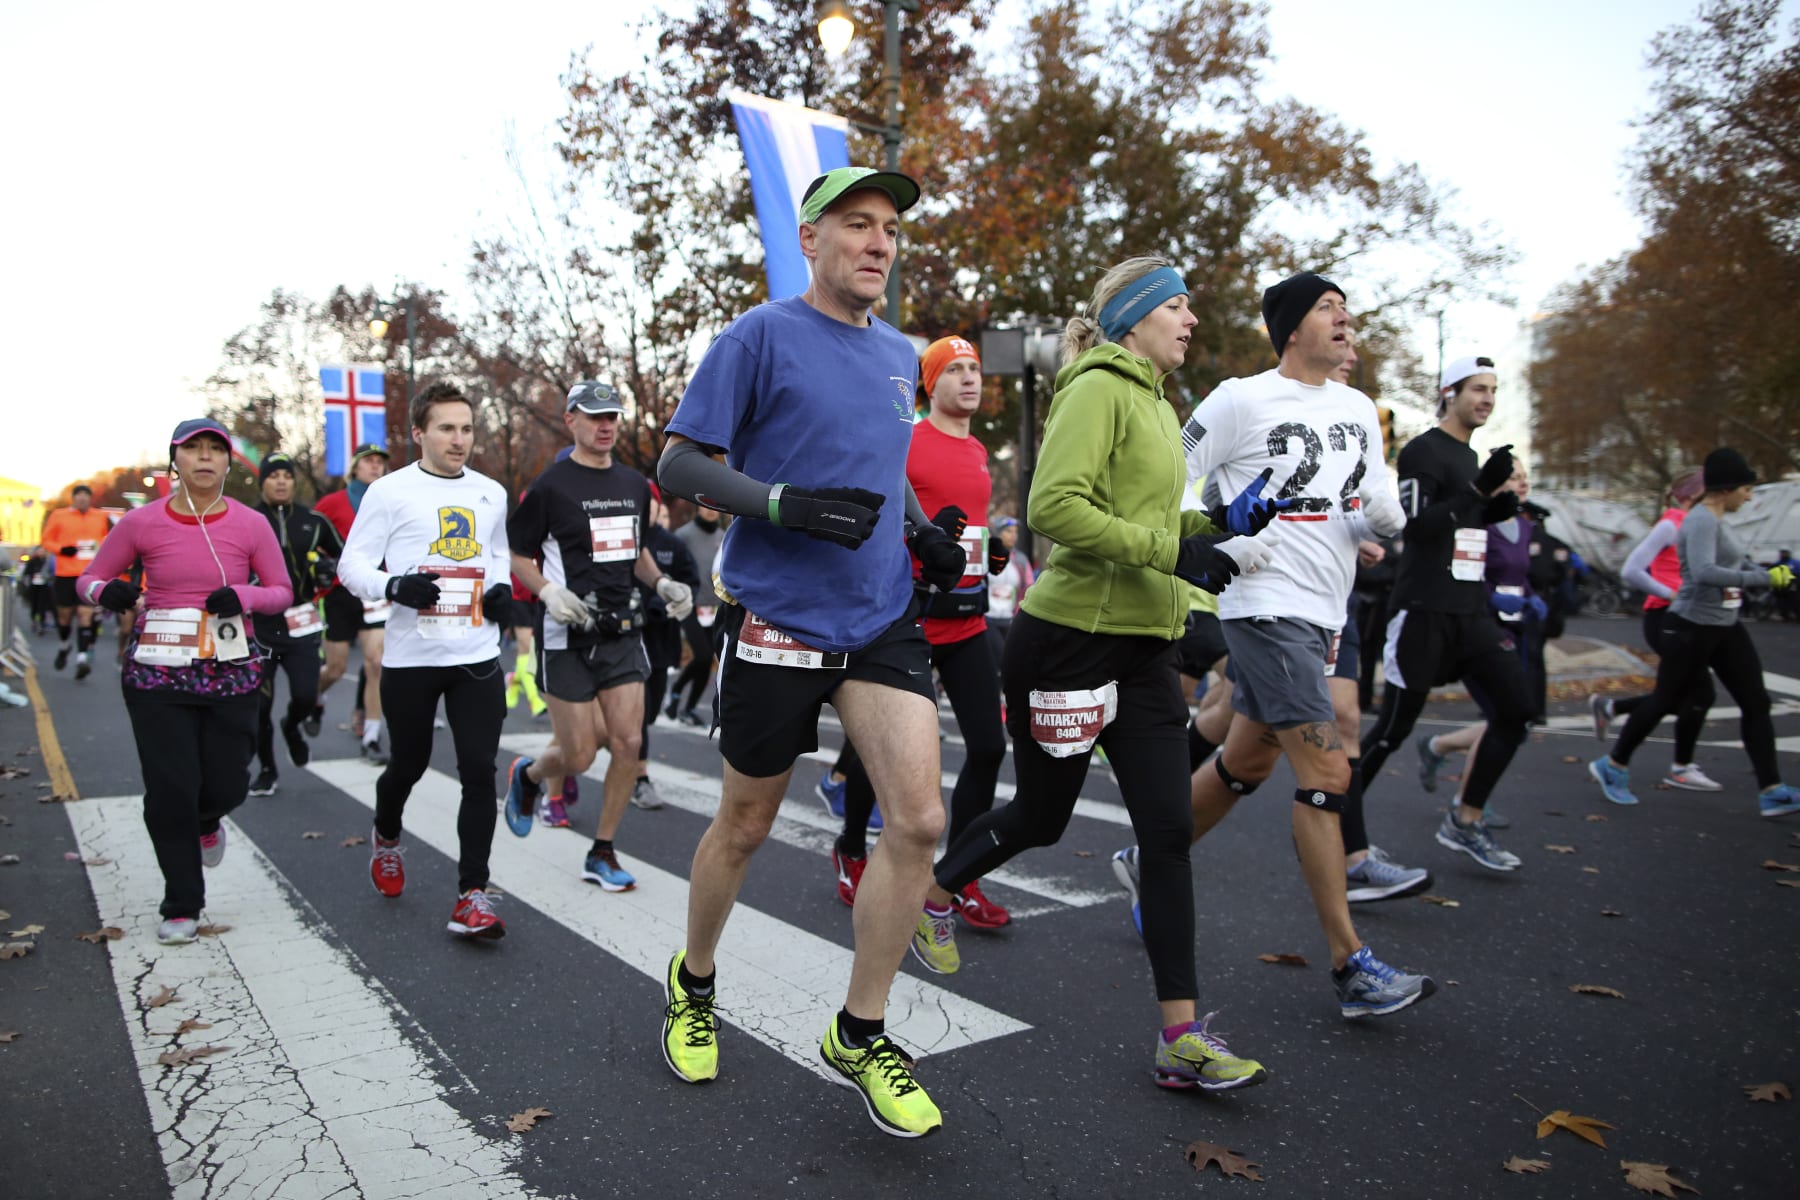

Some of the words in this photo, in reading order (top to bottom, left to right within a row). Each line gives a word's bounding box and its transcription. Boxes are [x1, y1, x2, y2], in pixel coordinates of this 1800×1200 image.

[1266, 422, 1368, 512] 22
[1035, 710, 1098, 727] KATARZYNA
[1056, 726, 1082, 739] 6400
